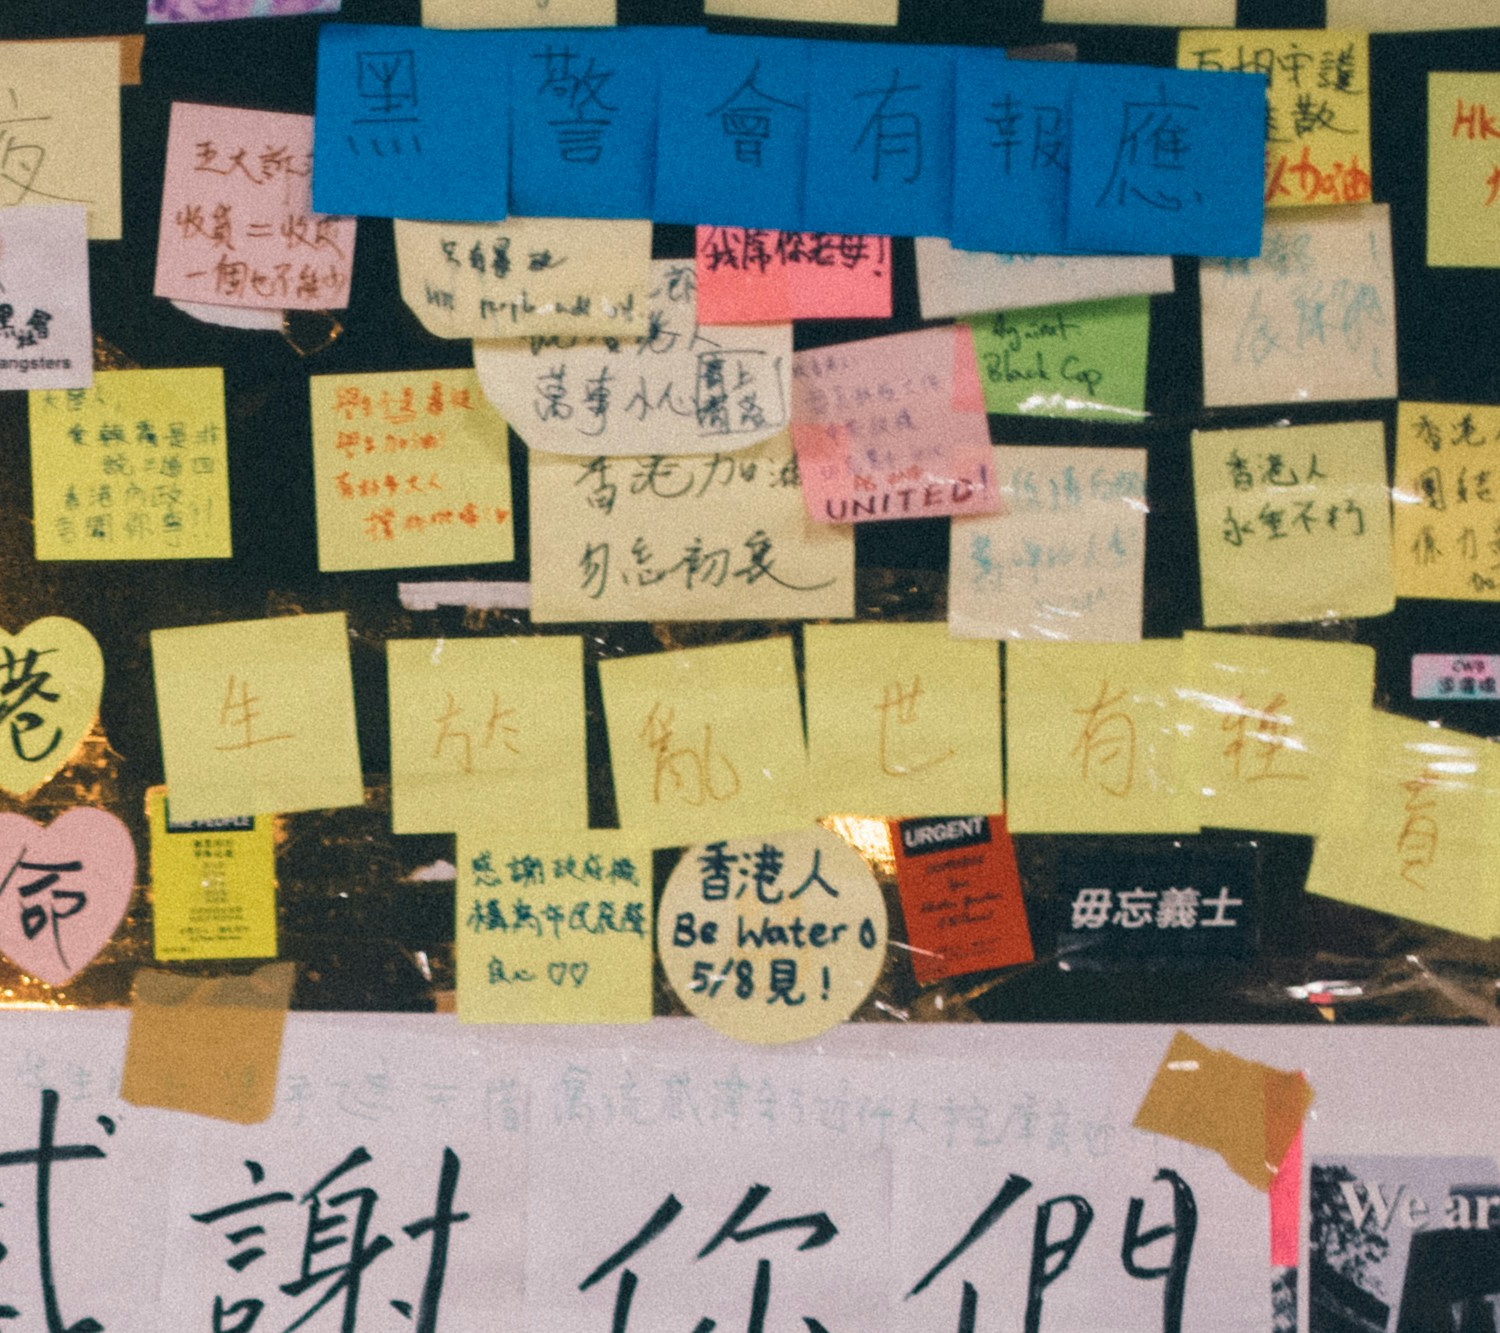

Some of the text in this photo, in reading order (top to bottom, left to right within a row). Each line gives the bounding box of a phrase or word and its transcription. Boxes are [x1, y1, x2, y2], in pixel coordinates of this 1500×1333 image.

[351, 43, 1203, 212] 黑警會有報應
[1222, 452, 1328, 492] 香港人
[903, 816, 986, 850] URGENT
[697, 842, 837, 903] 香港人
[1069, 886, 1244, 931] 毋忘義士
[671, 914, 848, 950] Be Water
